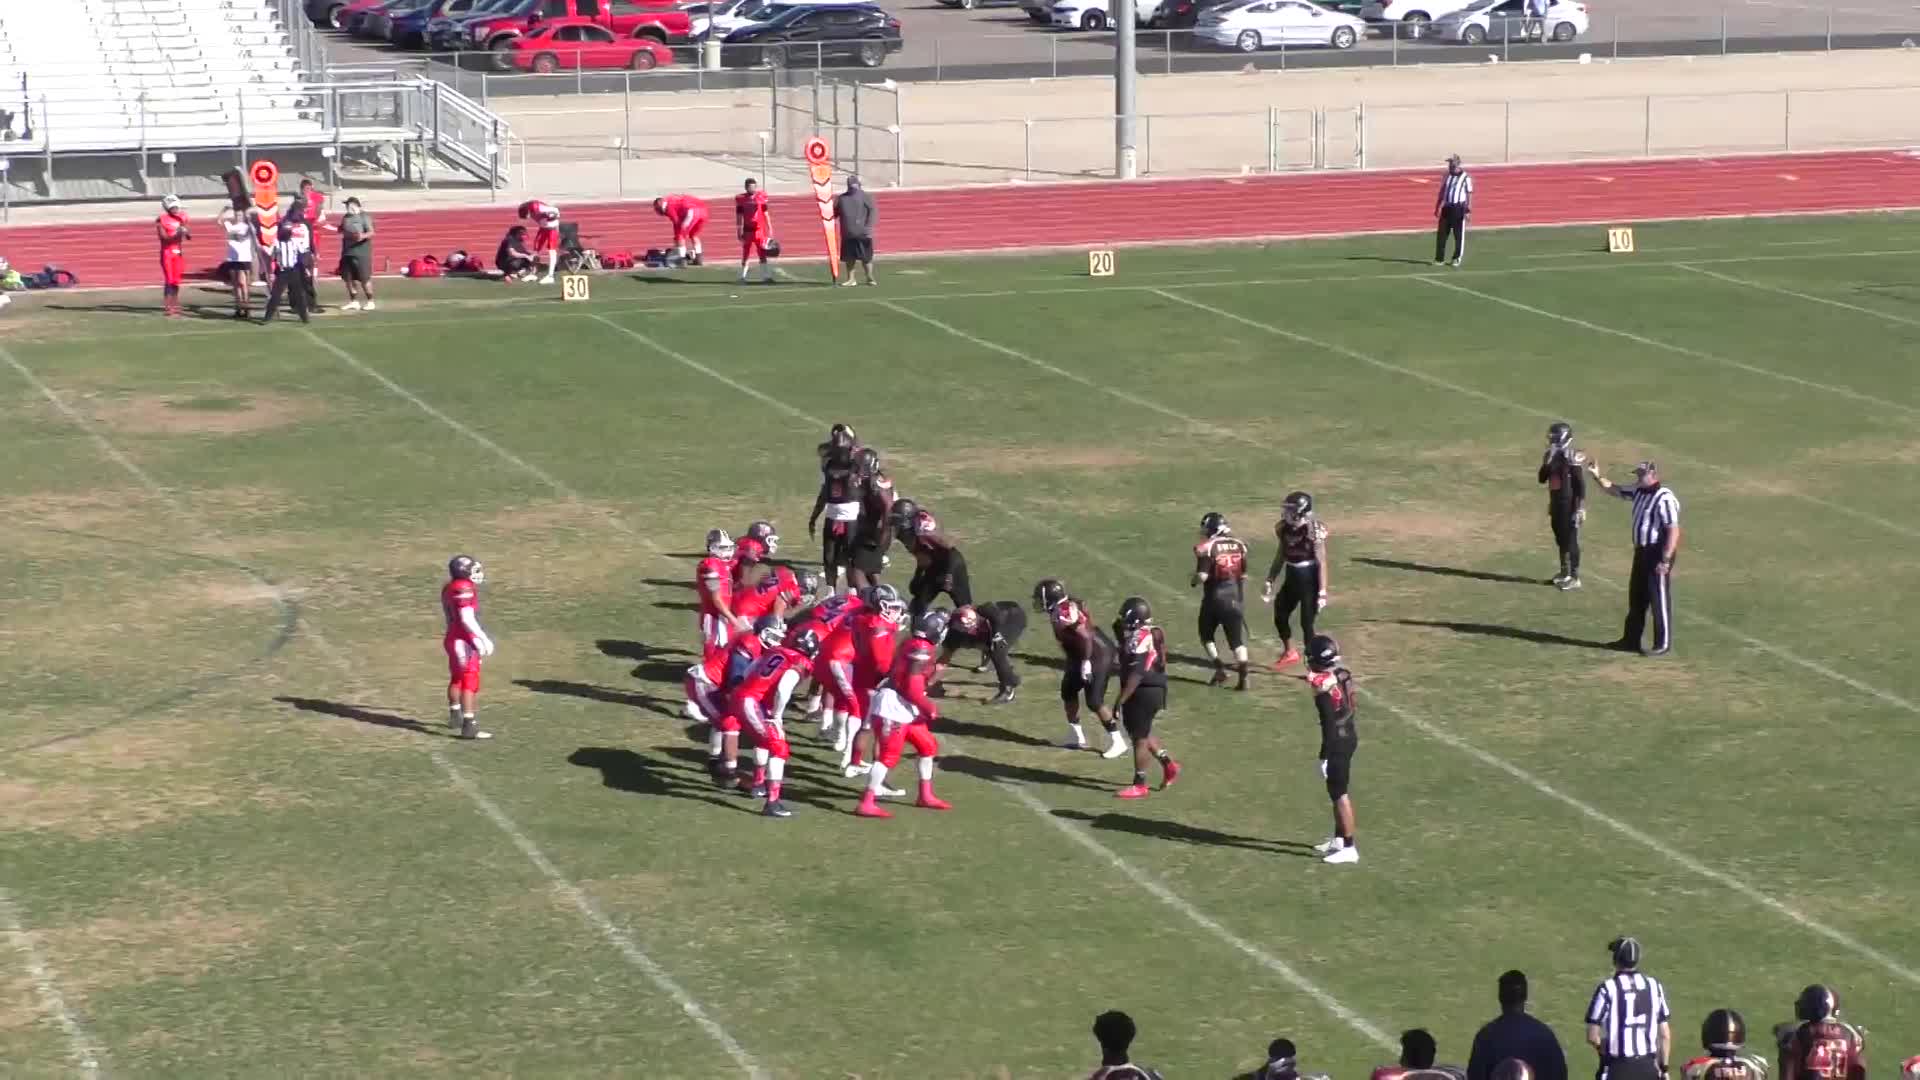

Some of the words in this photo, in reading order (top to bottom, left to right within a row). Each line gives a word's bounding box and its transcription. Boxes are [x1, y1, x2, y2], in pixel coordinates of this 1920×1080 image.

[1612, 230, 1630, 250] 10
[1092, 252, 1111, 273] 20
[566, 277, 585, 297] 30
[1624, 992, 1647, 1025] L
